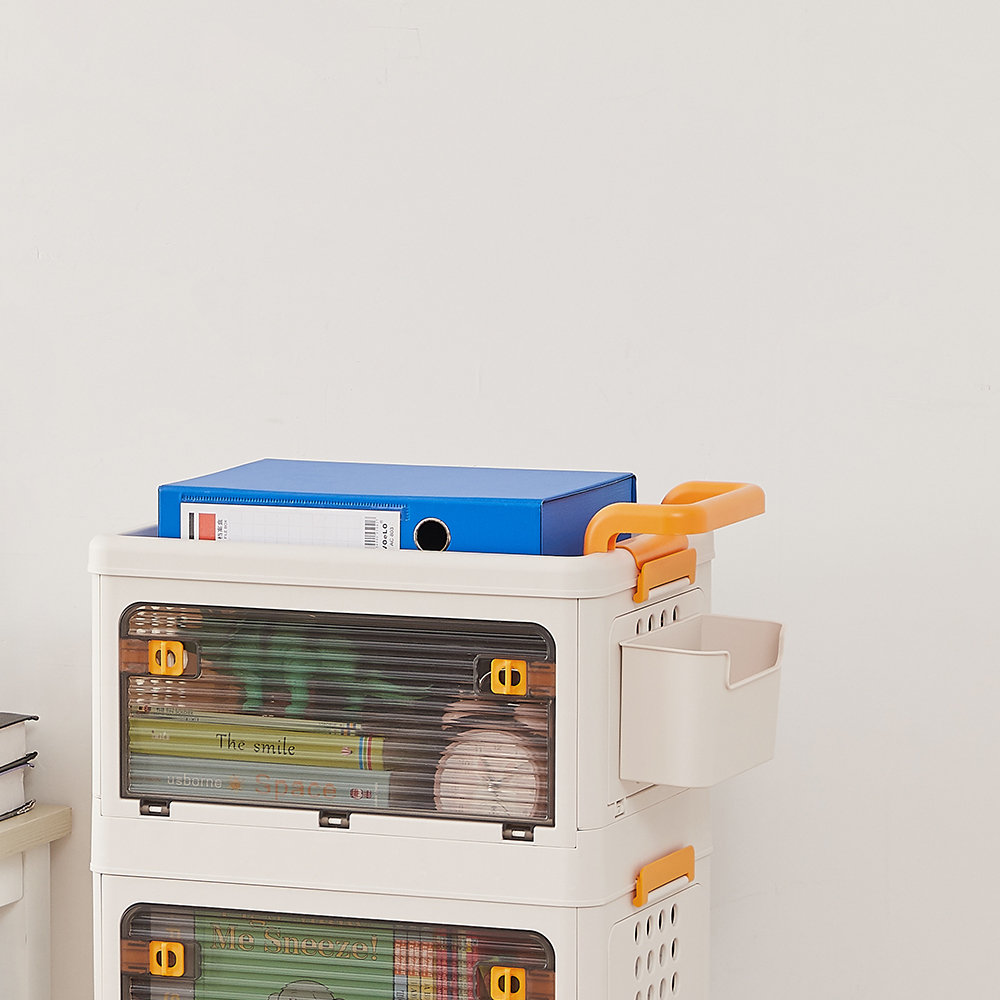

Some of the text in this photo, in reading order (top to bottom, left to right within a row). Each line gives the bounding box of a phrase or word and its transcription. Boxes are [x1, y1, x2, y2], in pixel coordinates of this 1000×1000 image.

[216, 733, 296, 756] The smile
[167, 773, 337, 800] usborne Space
[210, 924, 255, 951] Me
[264, 927, 378, 961] Sneeze!
